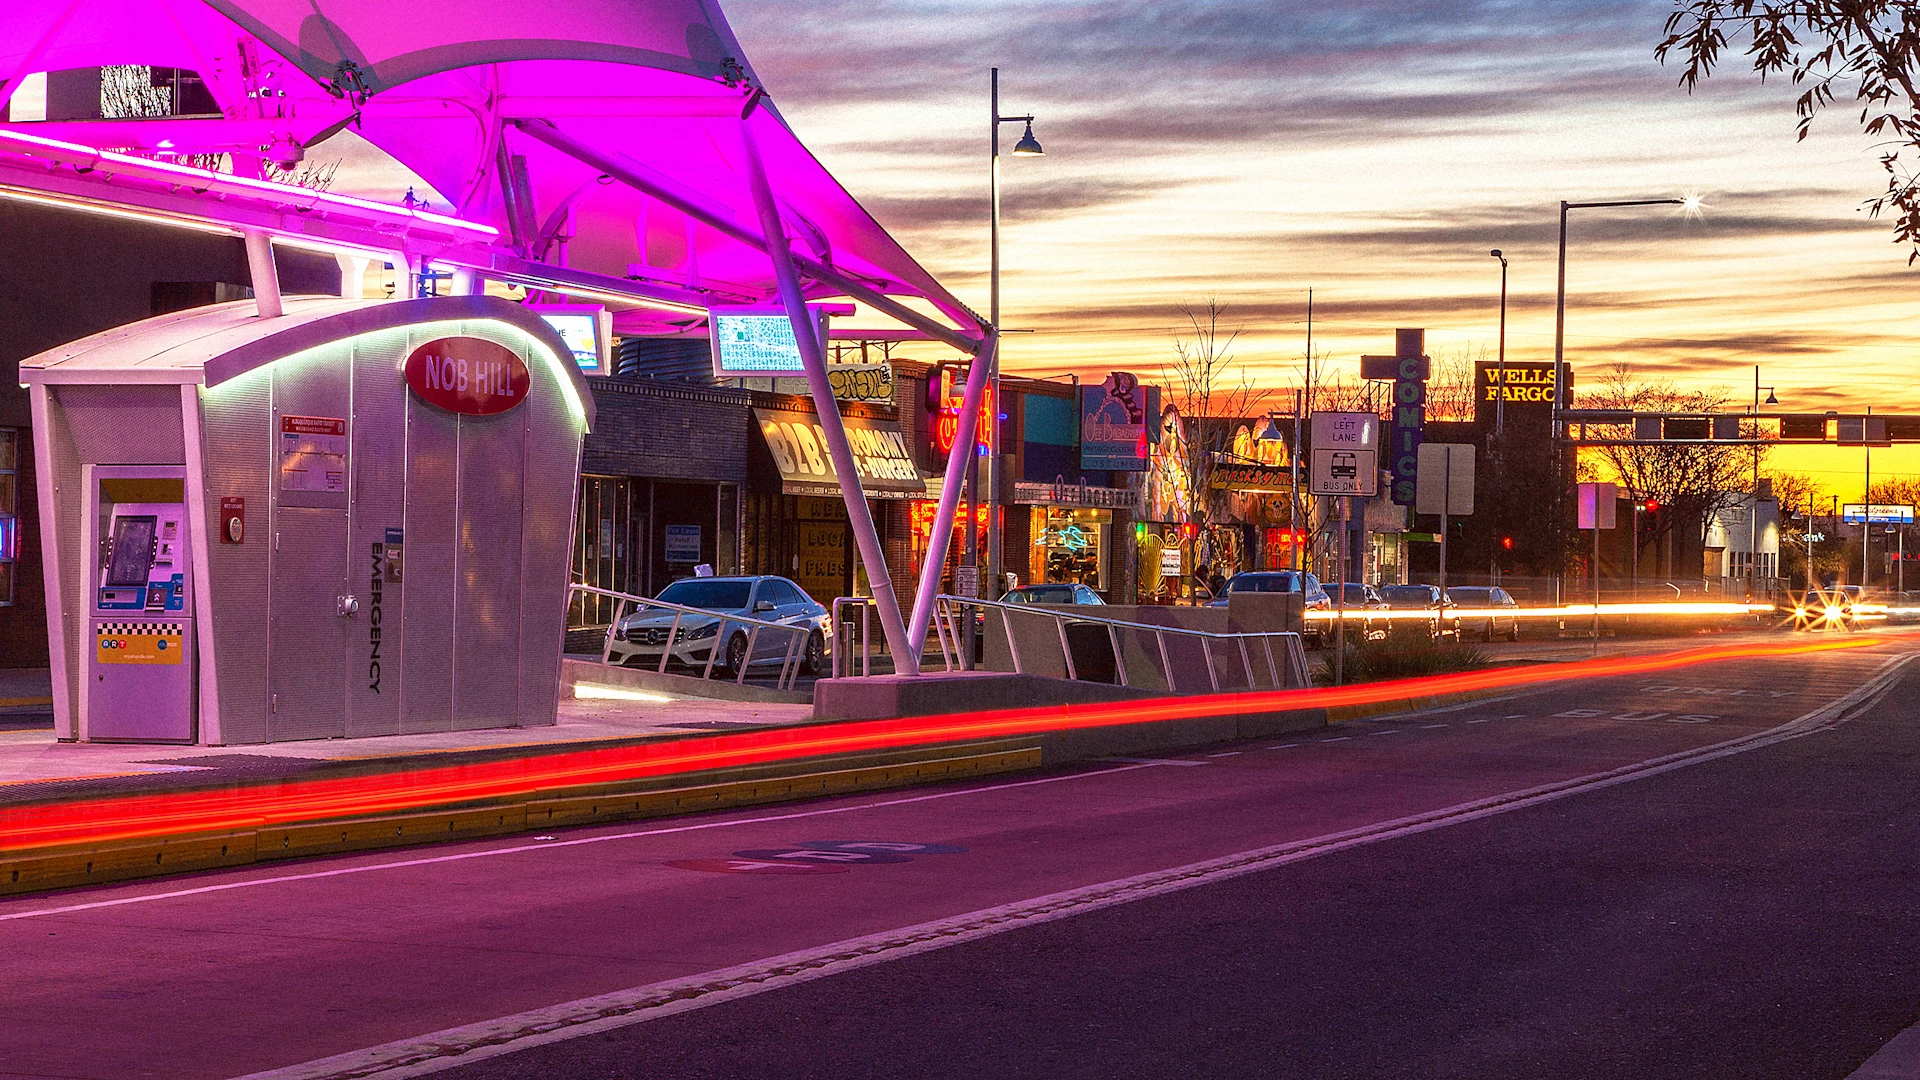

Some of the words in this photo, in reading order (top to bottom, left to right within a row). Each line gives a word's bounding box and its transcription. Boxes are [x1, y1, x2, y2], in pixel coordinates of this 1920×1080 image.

[425, 355, 468, 392] NOB
[475, 361, 514, 396] HILL
[1484, 368, 1556, 384] WELLS
[1485, 386, 1556, 402] FARGO
[1333, 421, 1356, 430] LEFT
[1397, 359, 1418, 501] COMICS
[1332, 433, 1357, 442] LANE
[761, 419, 826, 476] B2B
[813, 424, 909, 459] BRONOMY
[1083, 445, 1109, 453] VINTAGE
[865, 456, 918, 480] BURGERS
[1084, 460, 1142, 468] COSTUMES
[1323, 481, 1340, 490] BUS
[1342, 481, 1363, 491] ONLY
[369, 542, 383, 695] EMERGENCY
[102, 640, 126, 649] ART
[1639, 685, 1798, 698] ONLY
[1551, 708, 1720, 724] BUS
